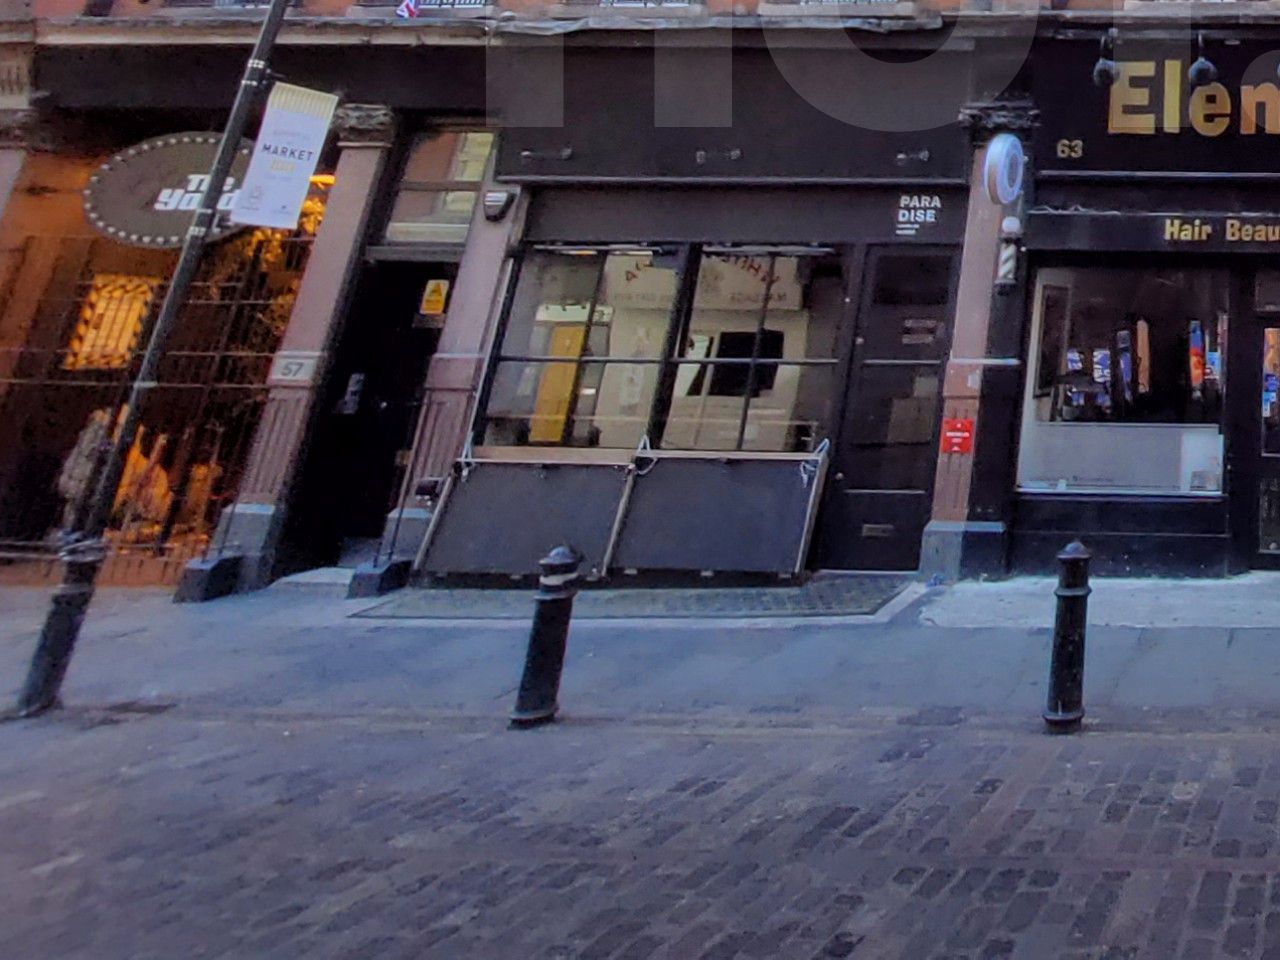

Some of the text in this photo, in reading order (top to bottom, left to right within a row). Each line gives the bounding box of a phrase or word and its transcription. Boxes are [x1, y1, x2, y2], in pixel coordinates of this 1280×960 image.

[261, 143, 314, 162] MARKET
[1056, 139, 1083, 158] 63
[900, 195, 942, 208] PARA
[897, 209, 937, 222] DISE
[1163, 218, 1213, 241] Hair
[281, 362, 303, 377] 57
